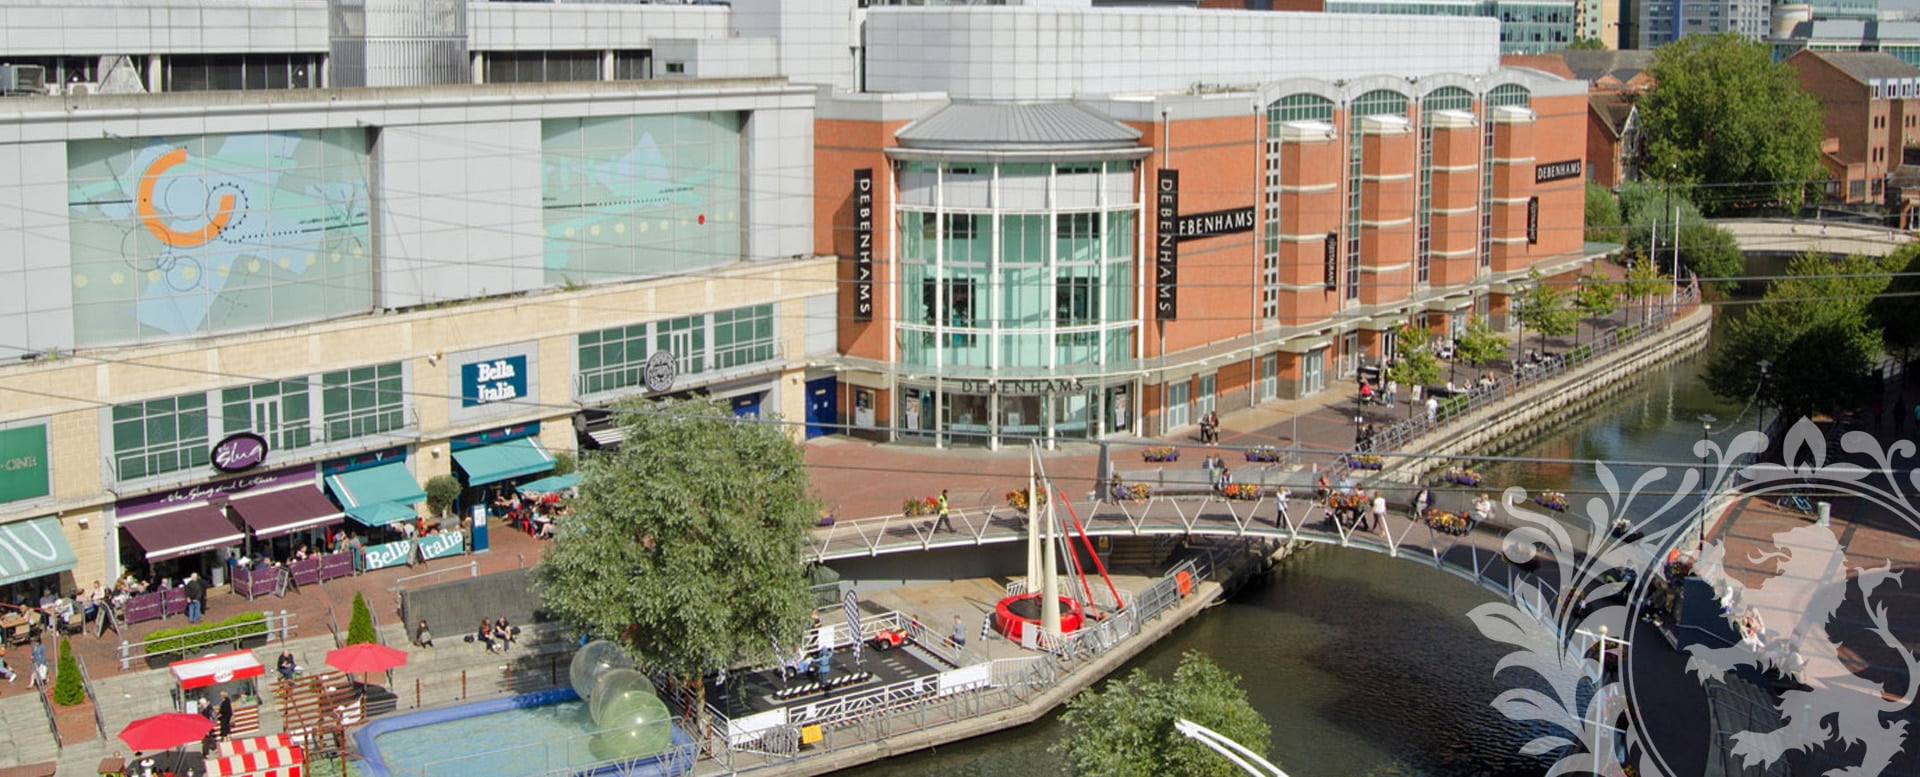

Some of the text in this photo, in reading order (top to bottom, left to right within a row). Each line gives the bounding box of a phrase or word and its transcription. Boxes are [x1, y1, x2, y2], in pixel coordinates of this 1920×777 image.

[1537, 162, 1580, 180] DEBENHAMS
[1179, 211, 1253, 236] EBENHAMS
[859, 178, 870, 313] DEBENHAMS
[1159, 178, 1173, 311] DEBENHAMS
[477, 360, 515, 382] Bella
[477, 382, 516, 403] Italia
[962, 381, 1084, 393] DEBENHAMS
[216, 442, 262, 468] Slug
[366, 530, 462, 569] Bella Italia
